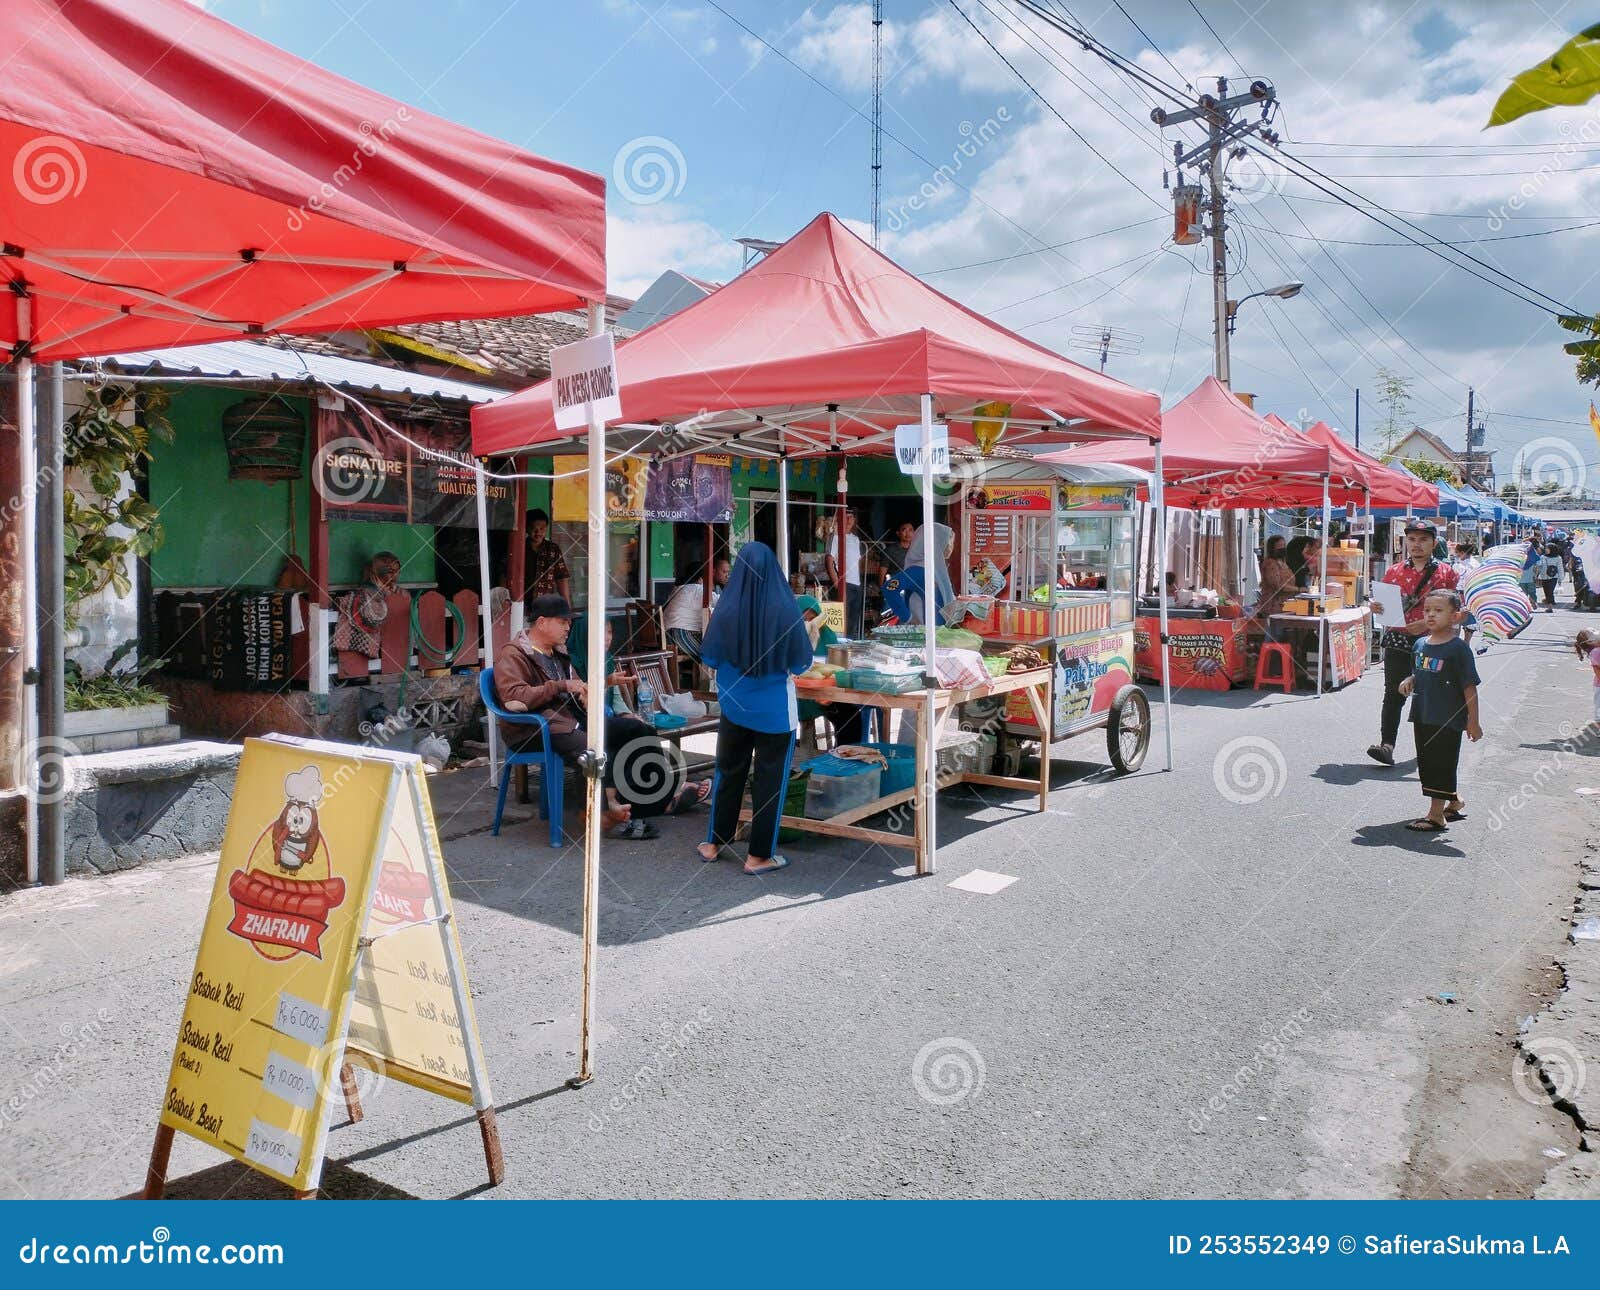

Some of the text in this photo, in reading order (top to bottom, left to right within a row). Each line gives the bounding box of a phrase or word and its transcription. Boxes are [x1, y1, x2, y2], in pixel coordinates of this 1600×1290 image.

[557, 365, 614, 408] PAK REBO RONDE
[326, 454, 403, 474] SIGNATURE
[438, 481, 476, 496] KUALITAS
[671, 477, 692, 487] CAMEL
[657, 509, 672, 518] YOU
[212, 596, 224, 680] SIGNAT
[258, 596, 271, 681] BIKIN KONTEN
[272, 621, 284, 648] YOU
[246, 647, 257, 680] JAGO
[272, 653, 284, 681] YES
[1172, 646, 1226, 665] LEVINA
[1064, 662, 1108, 685] Pak Eko
[242, 911, 311, 945] ZHAFRAN
[193, 971, 245, 1012] Sosbak Kecil
[182, 1020, 234, 1063] Sosbak Kecil
[167, 1087, 224, 1139] Sosbak Besar
